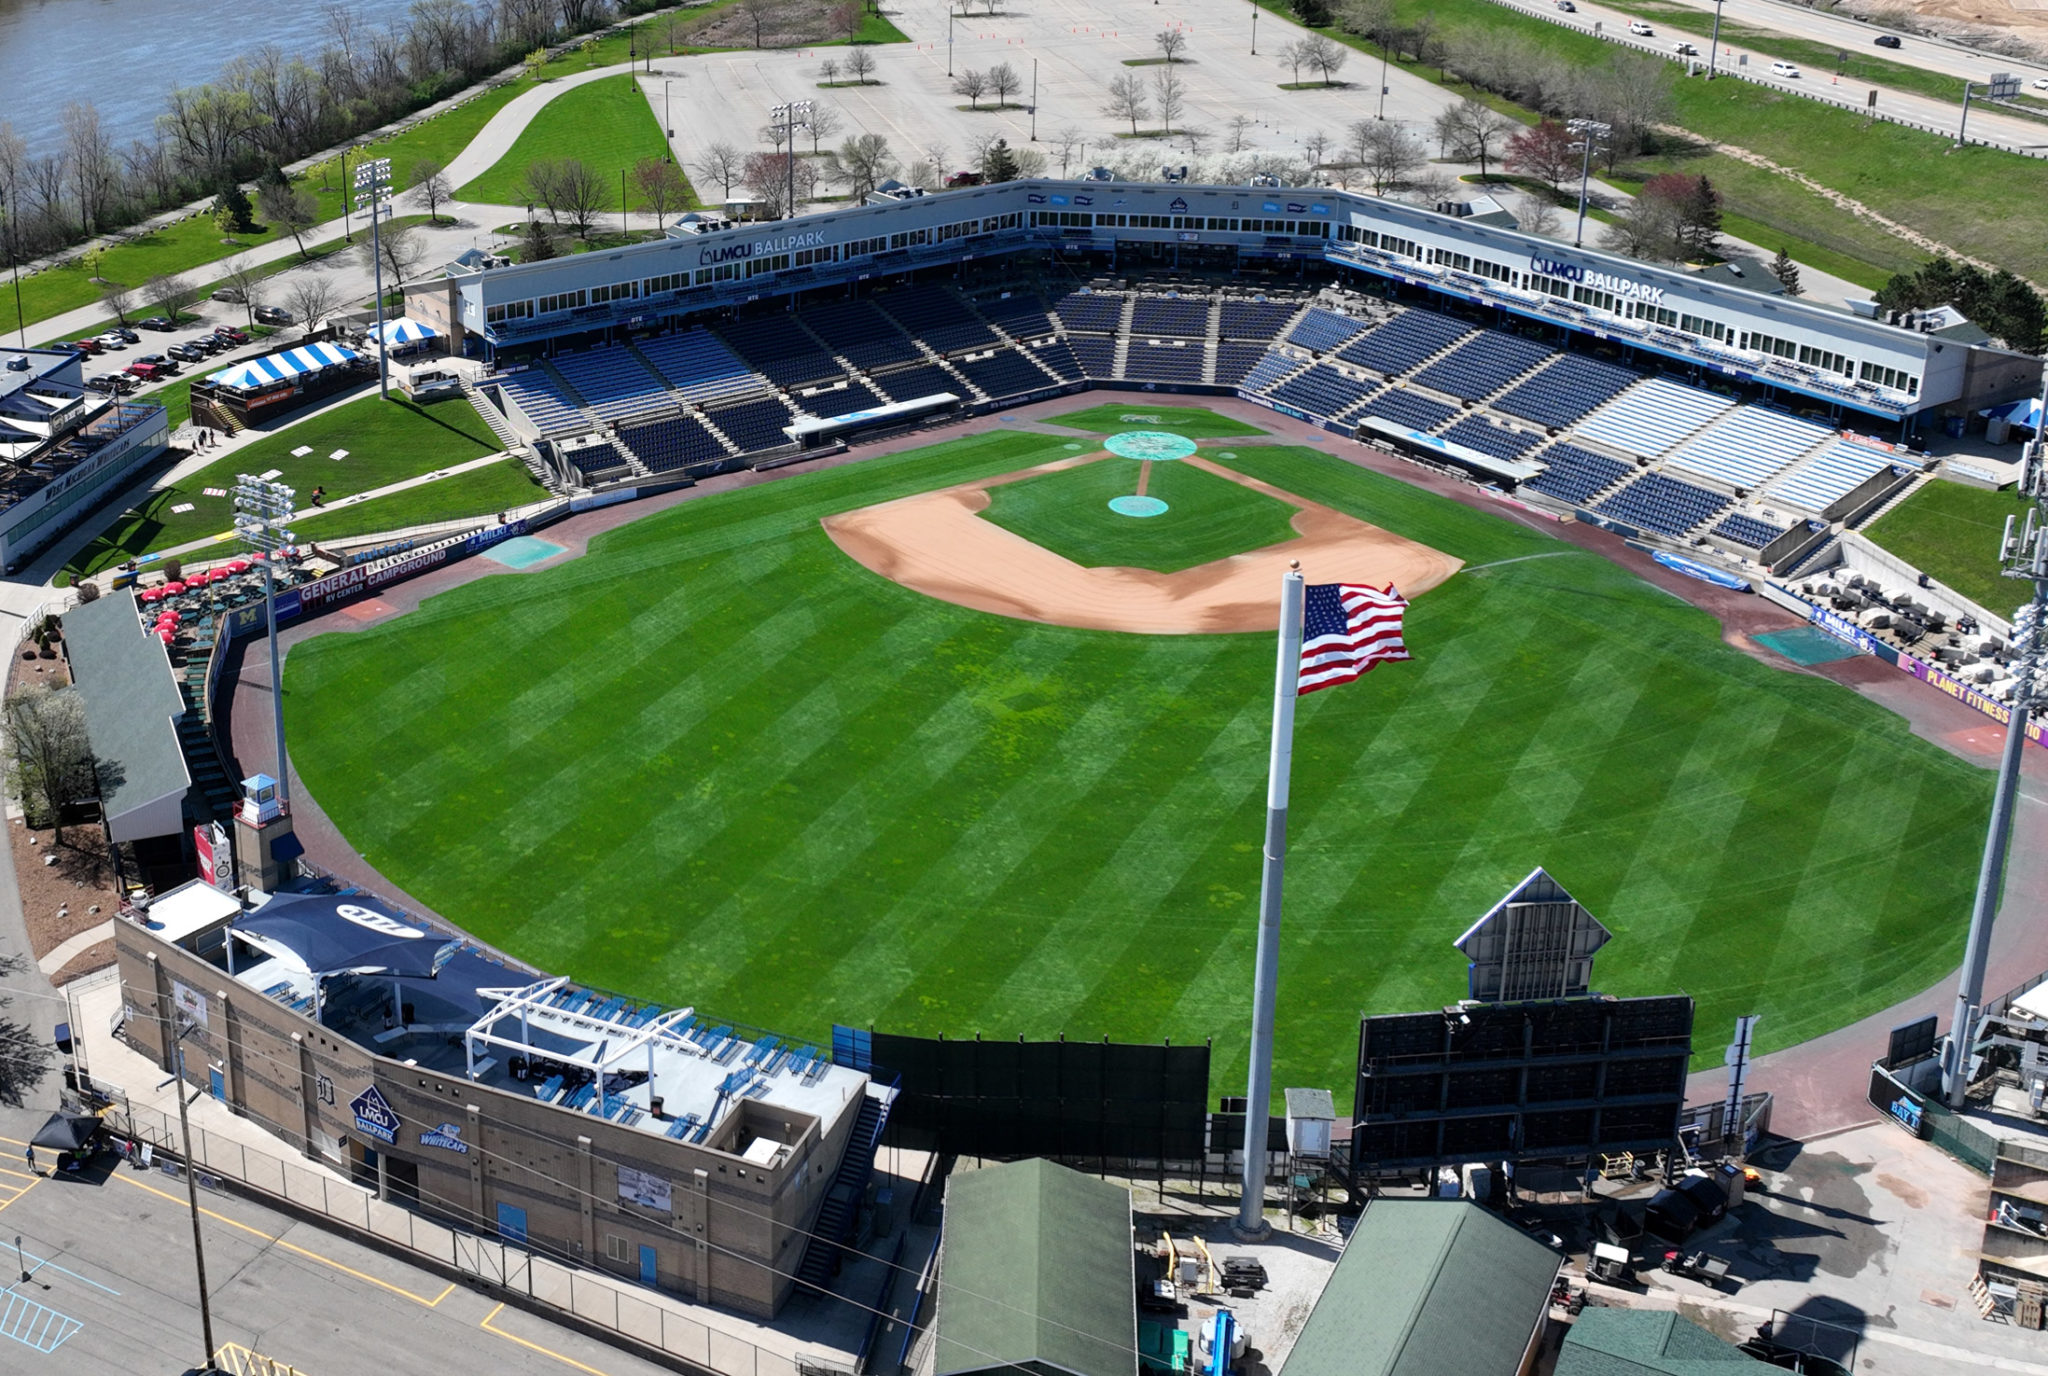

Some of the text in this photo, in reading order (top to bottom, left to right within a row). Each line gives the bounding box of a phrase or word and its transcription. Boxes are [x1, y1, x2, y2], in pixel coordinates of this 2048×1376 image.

[714, 231, 825, 262] LMCU BALLPARK
[1543, 259, 1665, 304] LMCU BALLPARK
[367, 550, 447, 587] CAMPGROUND
[301, 565, 367, 602] GENERAL
[325, 583, 364, 604] RV CENTER
[239, 608, 257, 626] M
[1824, 613, 1857, 637] MILK!
[1926, 669, 1966, 700] PLANET
[1966, 690, 2009, 724] FITNESS
[359, 1105, 389, 1127] LMCU
[1892, 1101, 1910, 1122] BAY
[356, 1118, 394, 1143] BALLPARK
[420, 1133, 469, 1154] WHITECAPS
